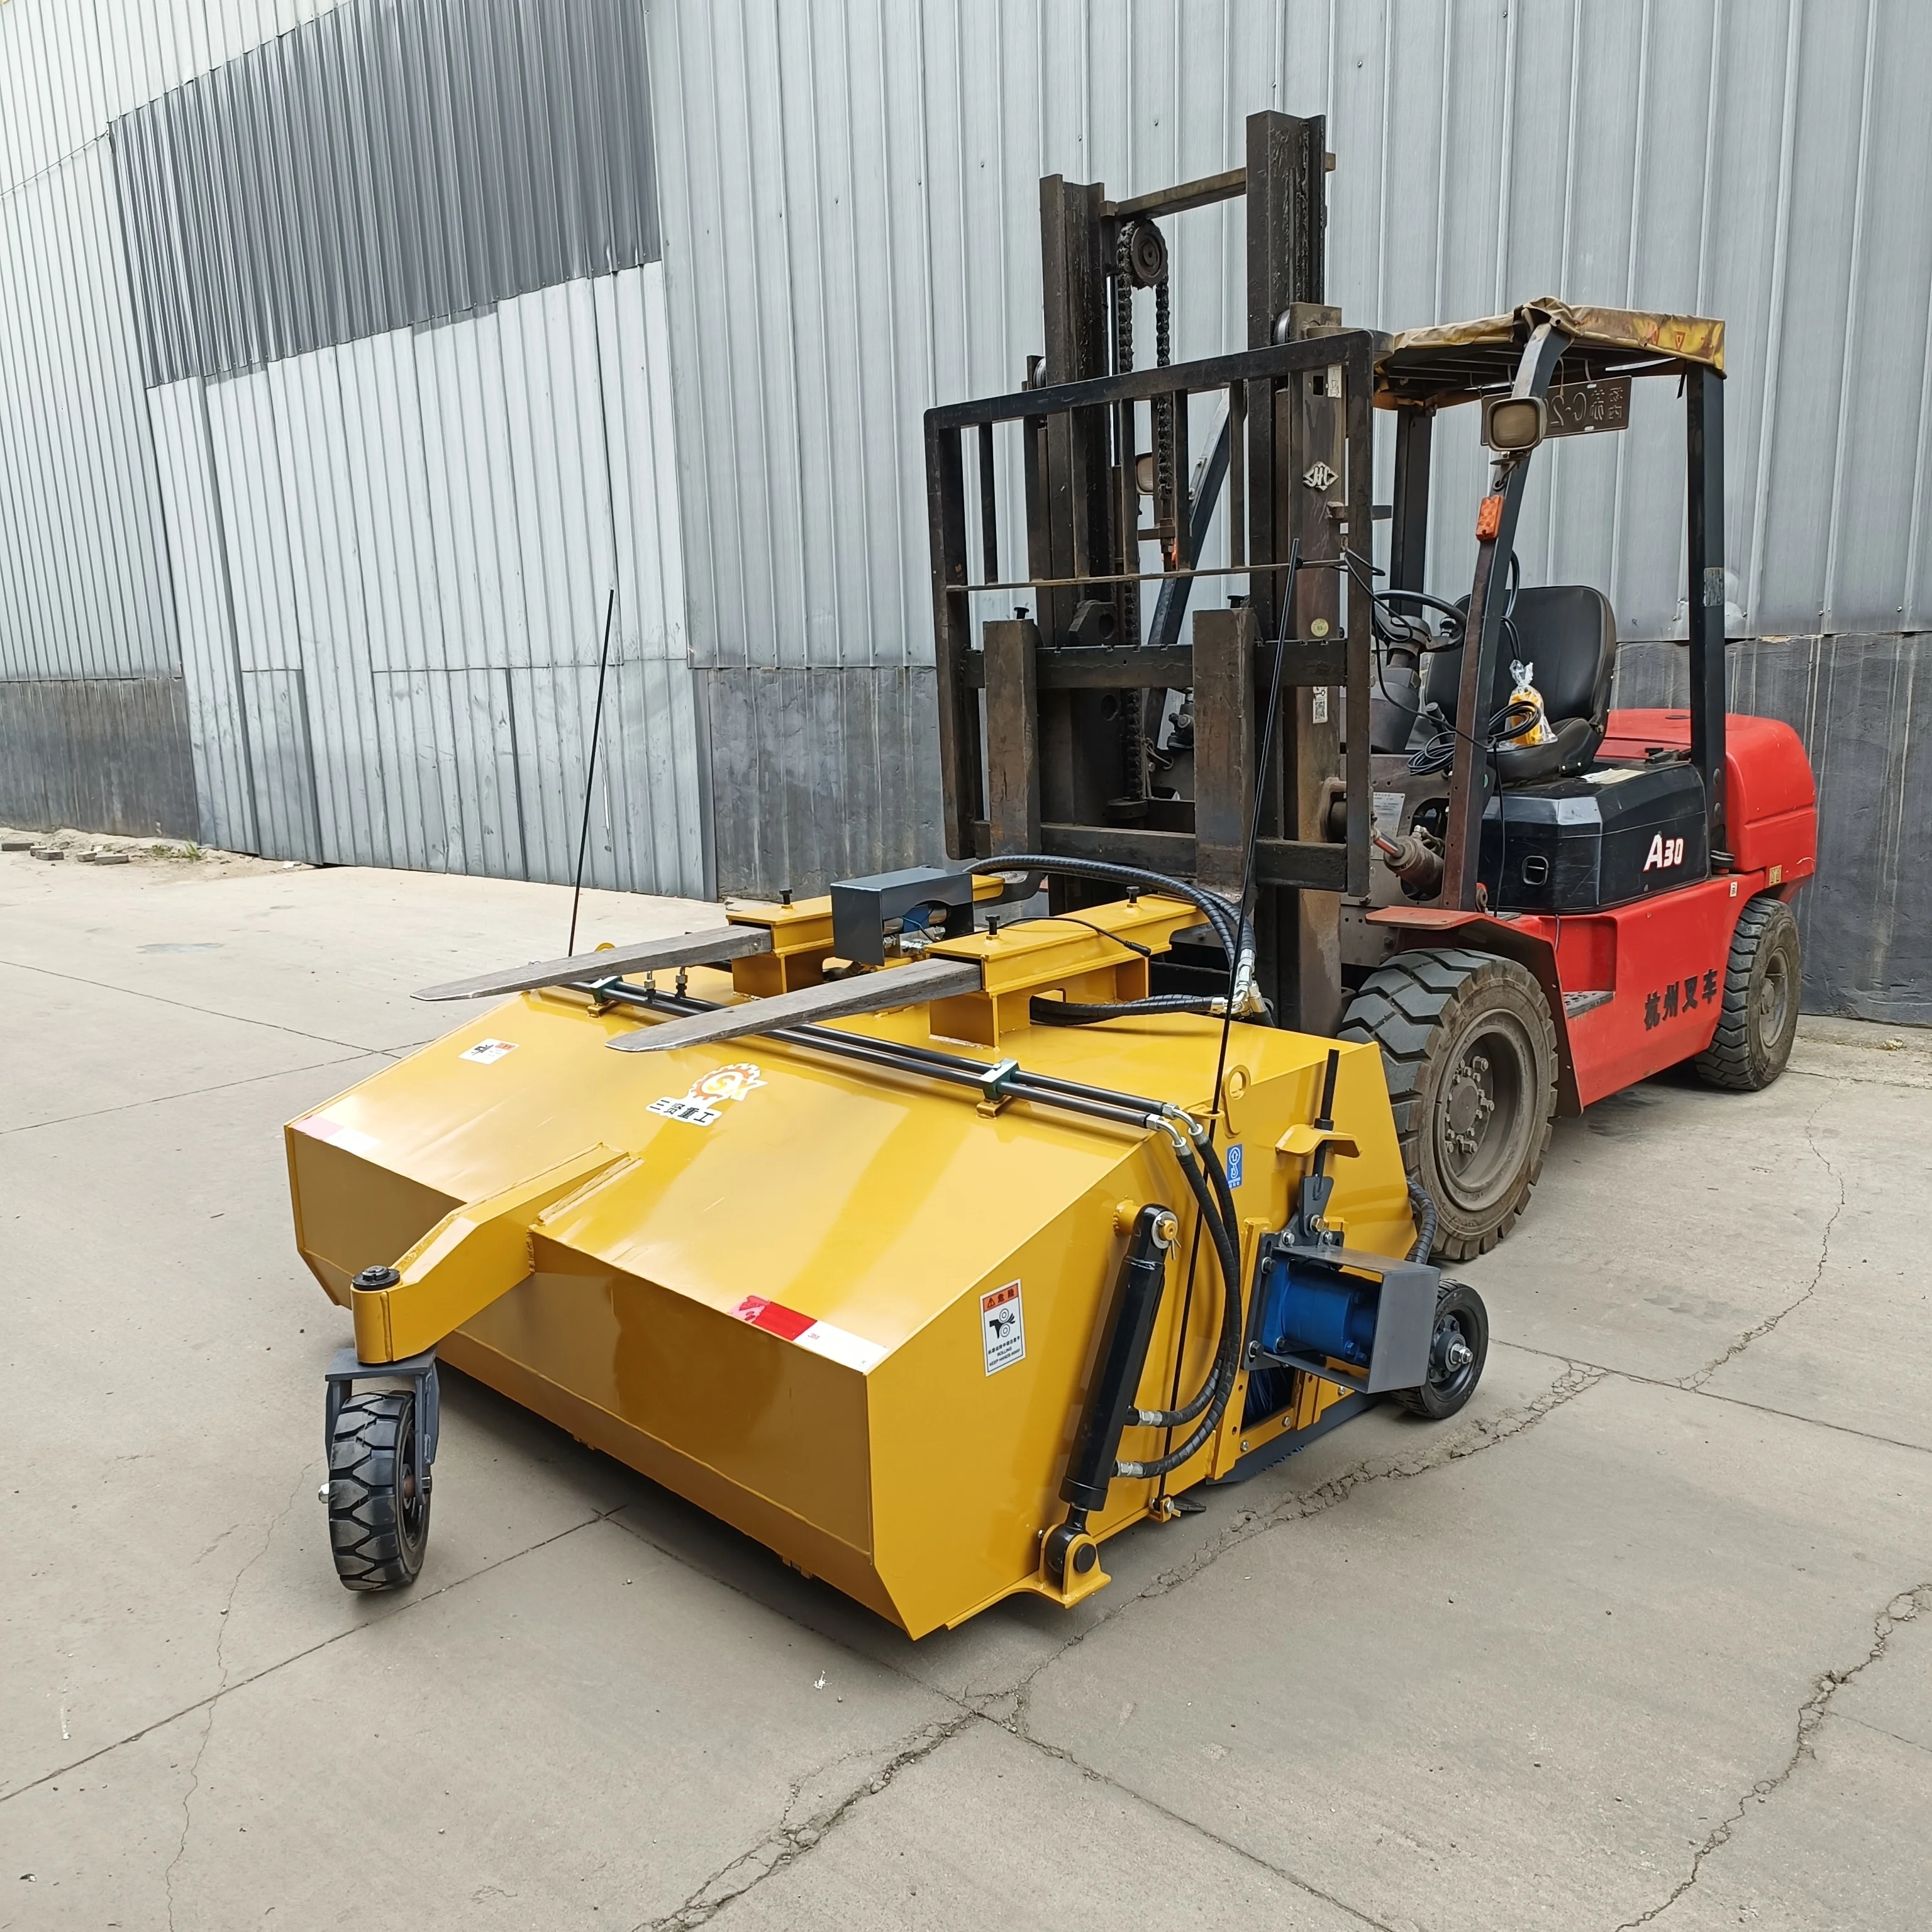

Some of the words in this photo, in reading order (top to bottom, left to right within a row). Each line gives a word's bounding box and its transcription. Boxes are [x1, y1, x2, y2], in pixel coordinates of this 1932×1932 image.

[1643, 833, 1684, 872] A30
[1643, 968, 1718, 1031] 杭州叉车
[649, 1099, 714, 1123] 三贤重工
[997, 1288, 1014, 1304] 危险
